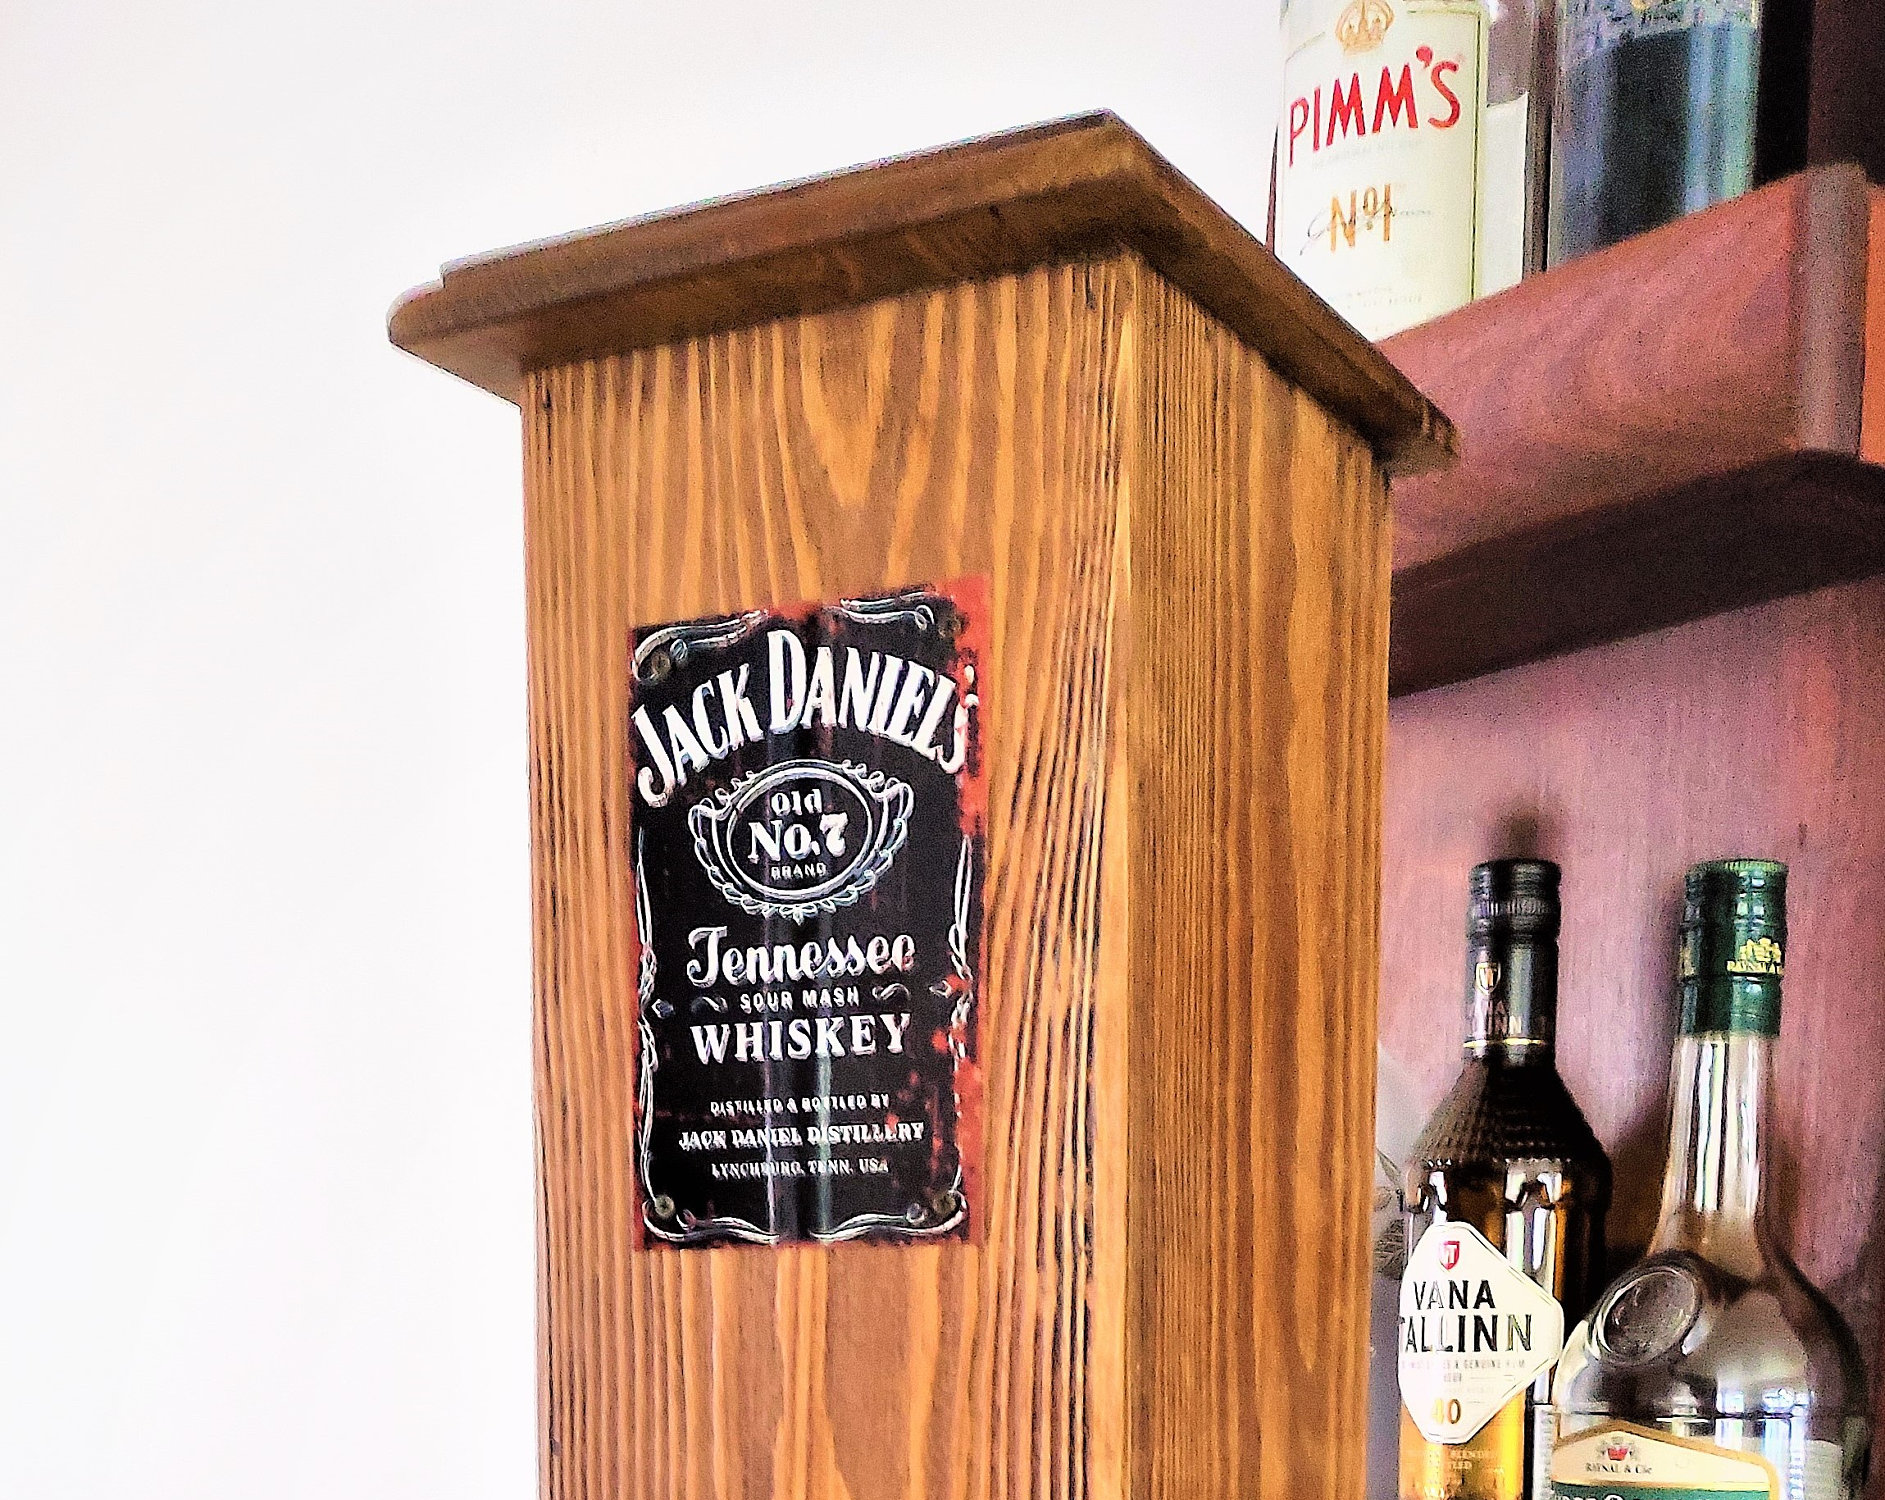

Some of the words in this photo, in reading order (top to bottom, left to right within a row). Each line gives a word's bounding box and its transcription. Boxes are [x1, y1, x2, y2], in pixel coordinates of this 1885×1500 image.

[1289, 45, 1461, 168] PIMM'S
[630, 663, 764, 808] JACK
[767, 629, 980, 775] DANIEL'S
[771, 862, 827, 880] BRAND
[686, 925, 916, 990] Tennessee
[739, 990, 793, 1014] SOUR
[801, 986, 860, 1010] MASH
[690, 1013, 912, 1065] WHISKEY
[710, 1097, 784, 1118] DISTILLED
[870, 1092, 890, 1109] BY
[678, 1129, 727, 1152] JACK
[731, 1126, 803, 1150] DANIEL
[806, 1121, 925, 1146] DISTILLERY
[858, 1157, 890, 1174] USA
[1413, 1279, 1497, 1311] VANA
